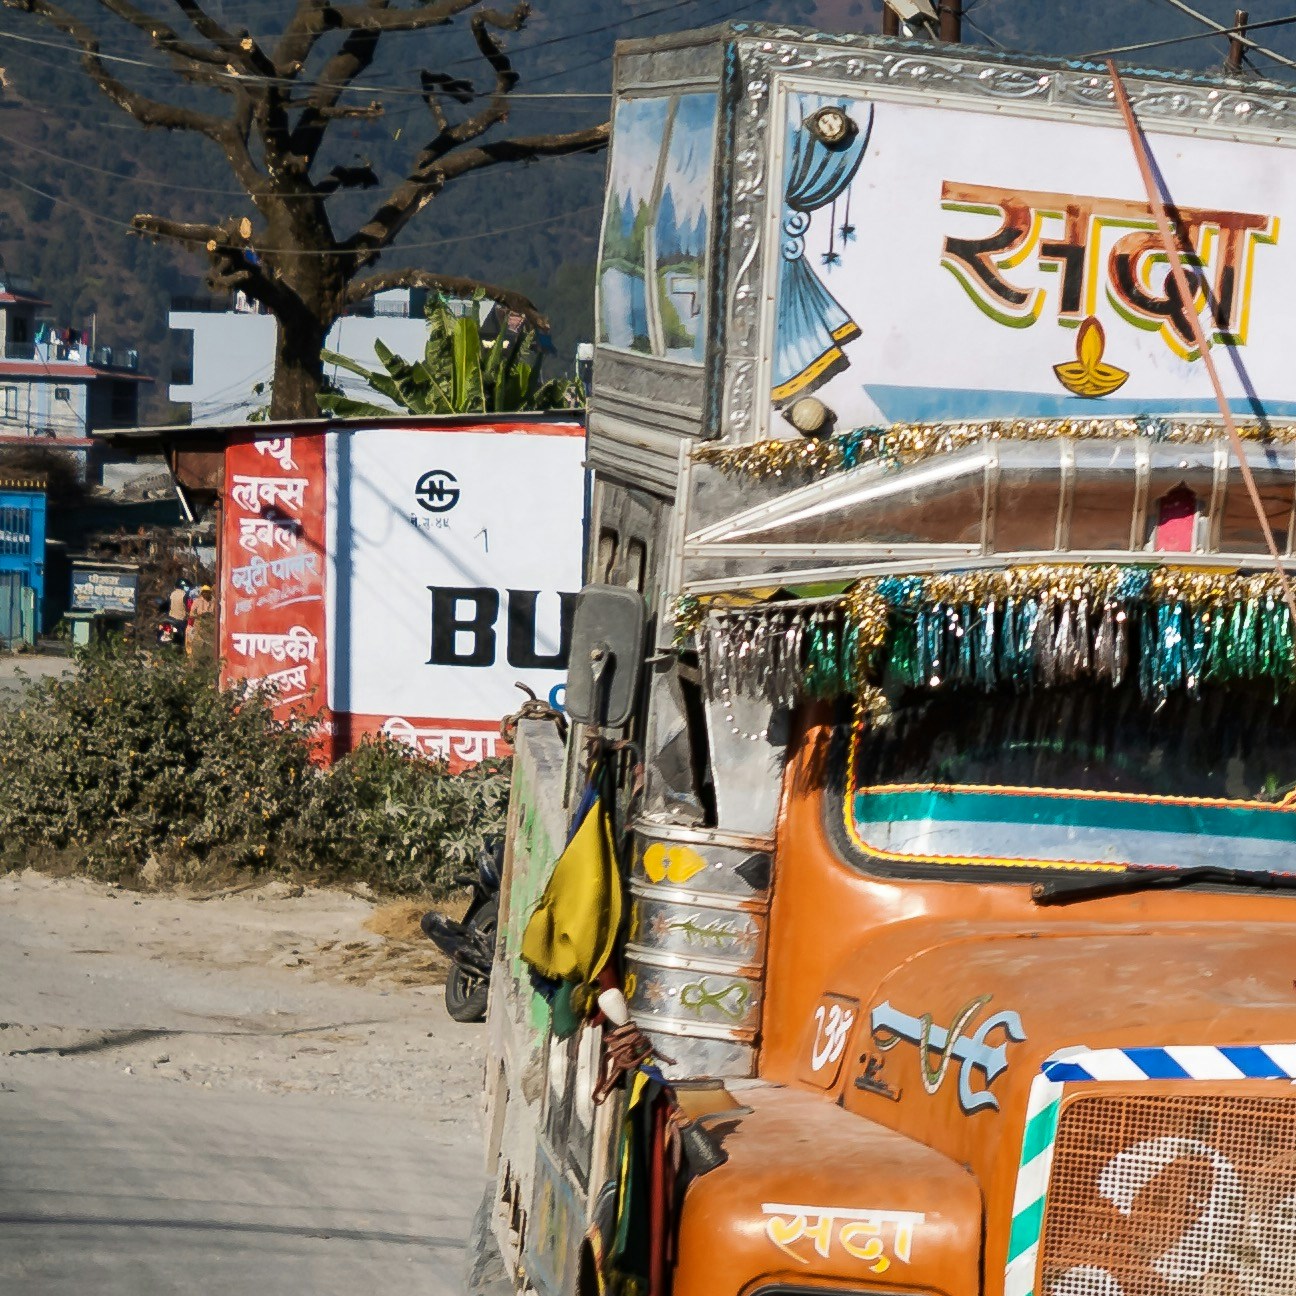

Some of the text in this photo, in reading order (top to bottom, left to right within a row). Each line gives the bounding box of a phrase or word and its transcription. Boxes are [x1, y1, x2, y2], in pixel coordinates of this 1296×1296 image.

[940, 180, 1281, 362] सदा
[231, 625, 318, 663] गण्डकी
[761, 1203, 926, 1273] सदा
